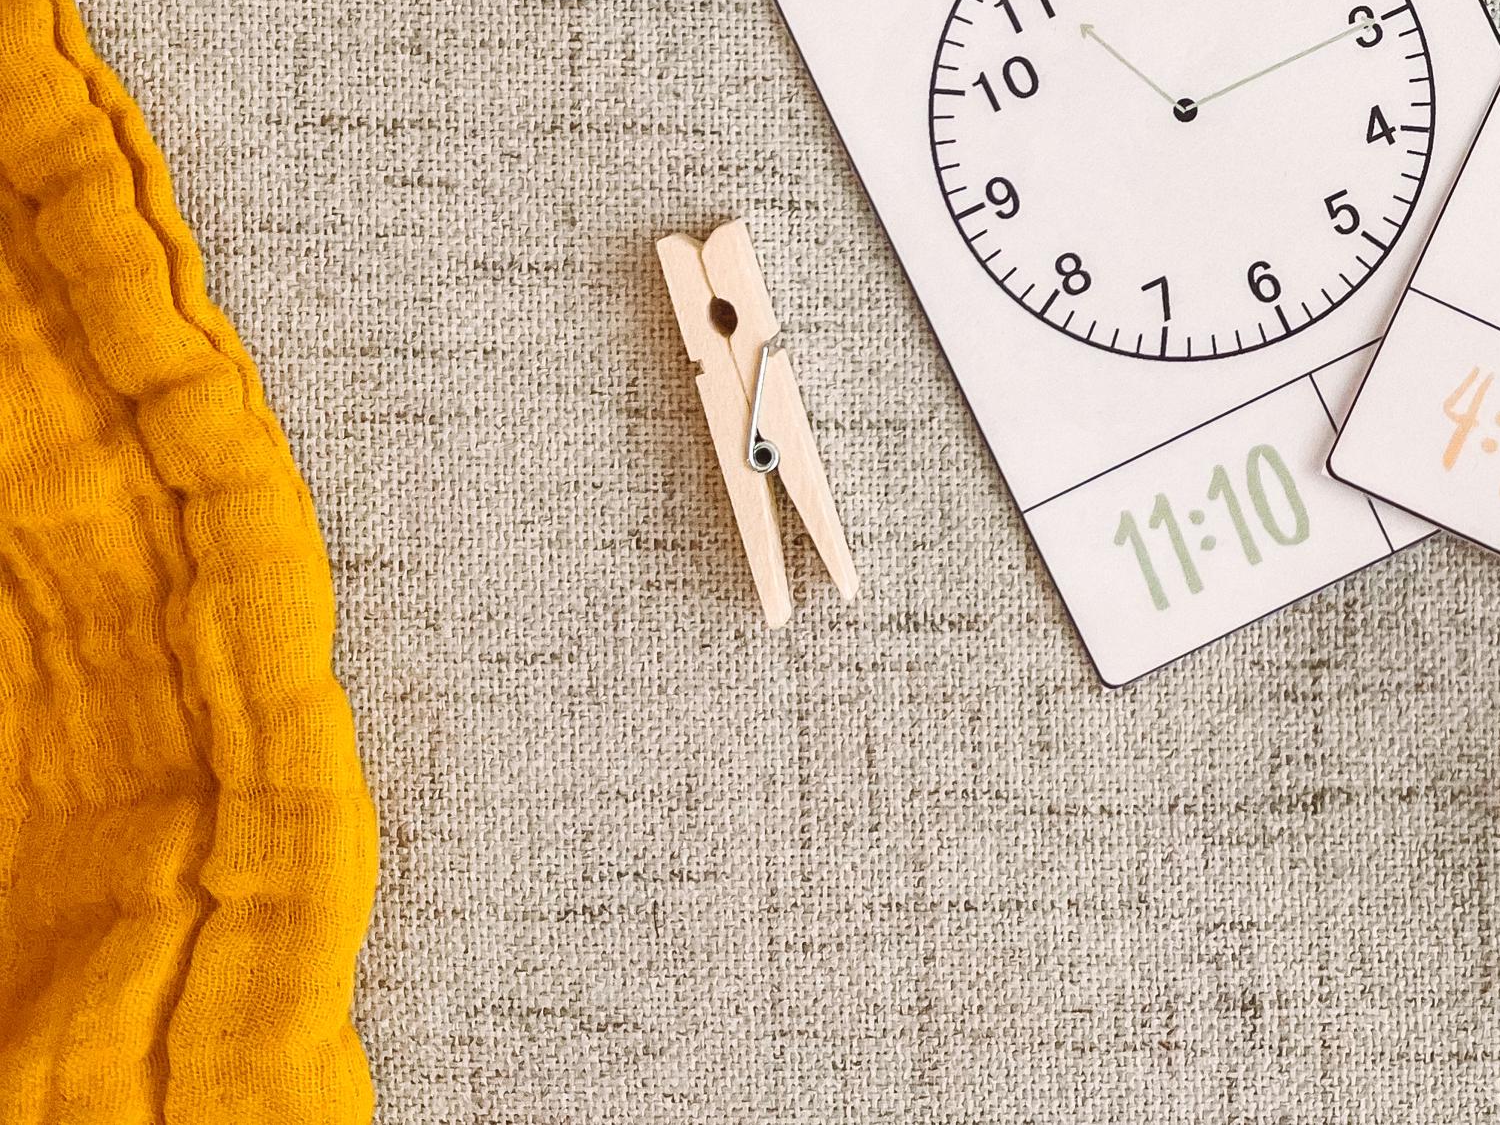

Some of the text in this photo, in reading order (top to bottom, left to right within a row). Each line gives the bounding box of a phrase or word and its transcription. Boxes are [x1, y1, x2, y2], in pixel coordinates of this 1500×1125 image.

[1348, 5, 1383, 47] 3
[972, 56, 1039, 112] 10
[1366, 105, 1397, 145] 4
[985, 177, 1020, 219] 9
[1324, 190, 1360, 234] 5
[1055, 253, 1091, 296] 8
[1248, 261, 1281, 303] 6
[1141, 276, 1171, 322] 7
[1113, 443, 1310, 611] 11:10
